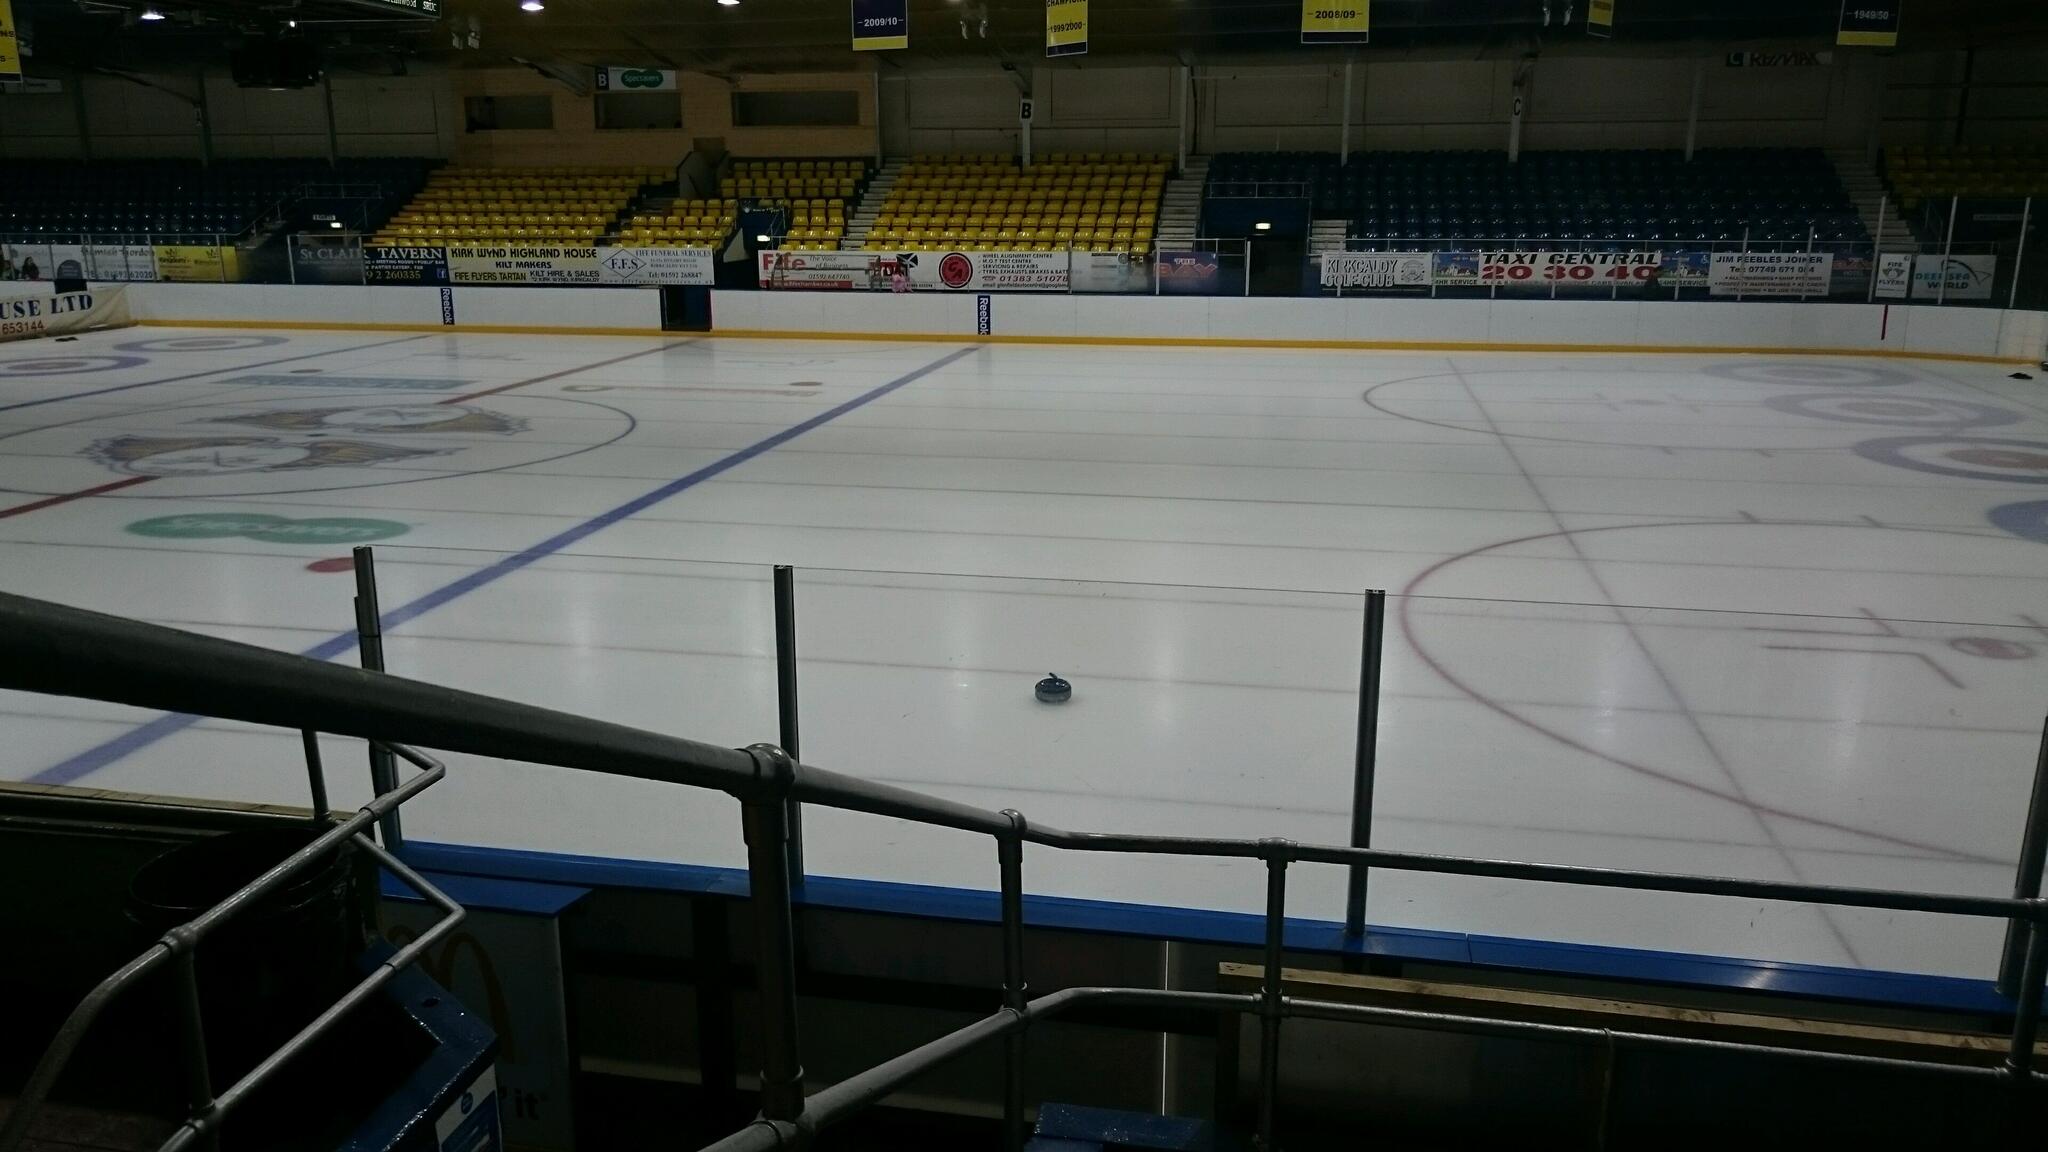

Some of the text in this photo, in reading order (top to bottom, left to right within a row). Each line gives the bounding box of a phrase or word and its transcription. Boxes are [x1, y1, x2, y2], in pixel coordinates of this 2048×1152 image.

[1314, 10, 1356, 19] 2008/09
[863, 17, 898, 27] 2009/10
[598, 73, 608, 87] B
[1022, 103, 1031, 119] B
[1514, 98, 1521, 115] C
[378, 247, 443, 260] TAVERN
[451, 248, 597, 258] KIRK WYND HIGHLAND HOUSE
[1482, 253, 1538, 264] TAXI
[1548, 253, 1659, 265] CENTRAL
[495, 261, 552, 269] KILT MAKERS
[762, 253, 806, 270] Ffe
[1326, 259, 1398, 273] KIRKCALDY
[1736, 256, 1782, 264] PEEBLES
[384, 270, 420, 280] 260335
[454, 272, 526, 281] FIFE FLYERS TARTAN
[1482, 265, 1657, 280] 20 30 40
[1325, 273, 1395, 287] GOLF CLUB
[51, 294, 94, 314] LTD
[442, 288, 454, 324] Reebok
